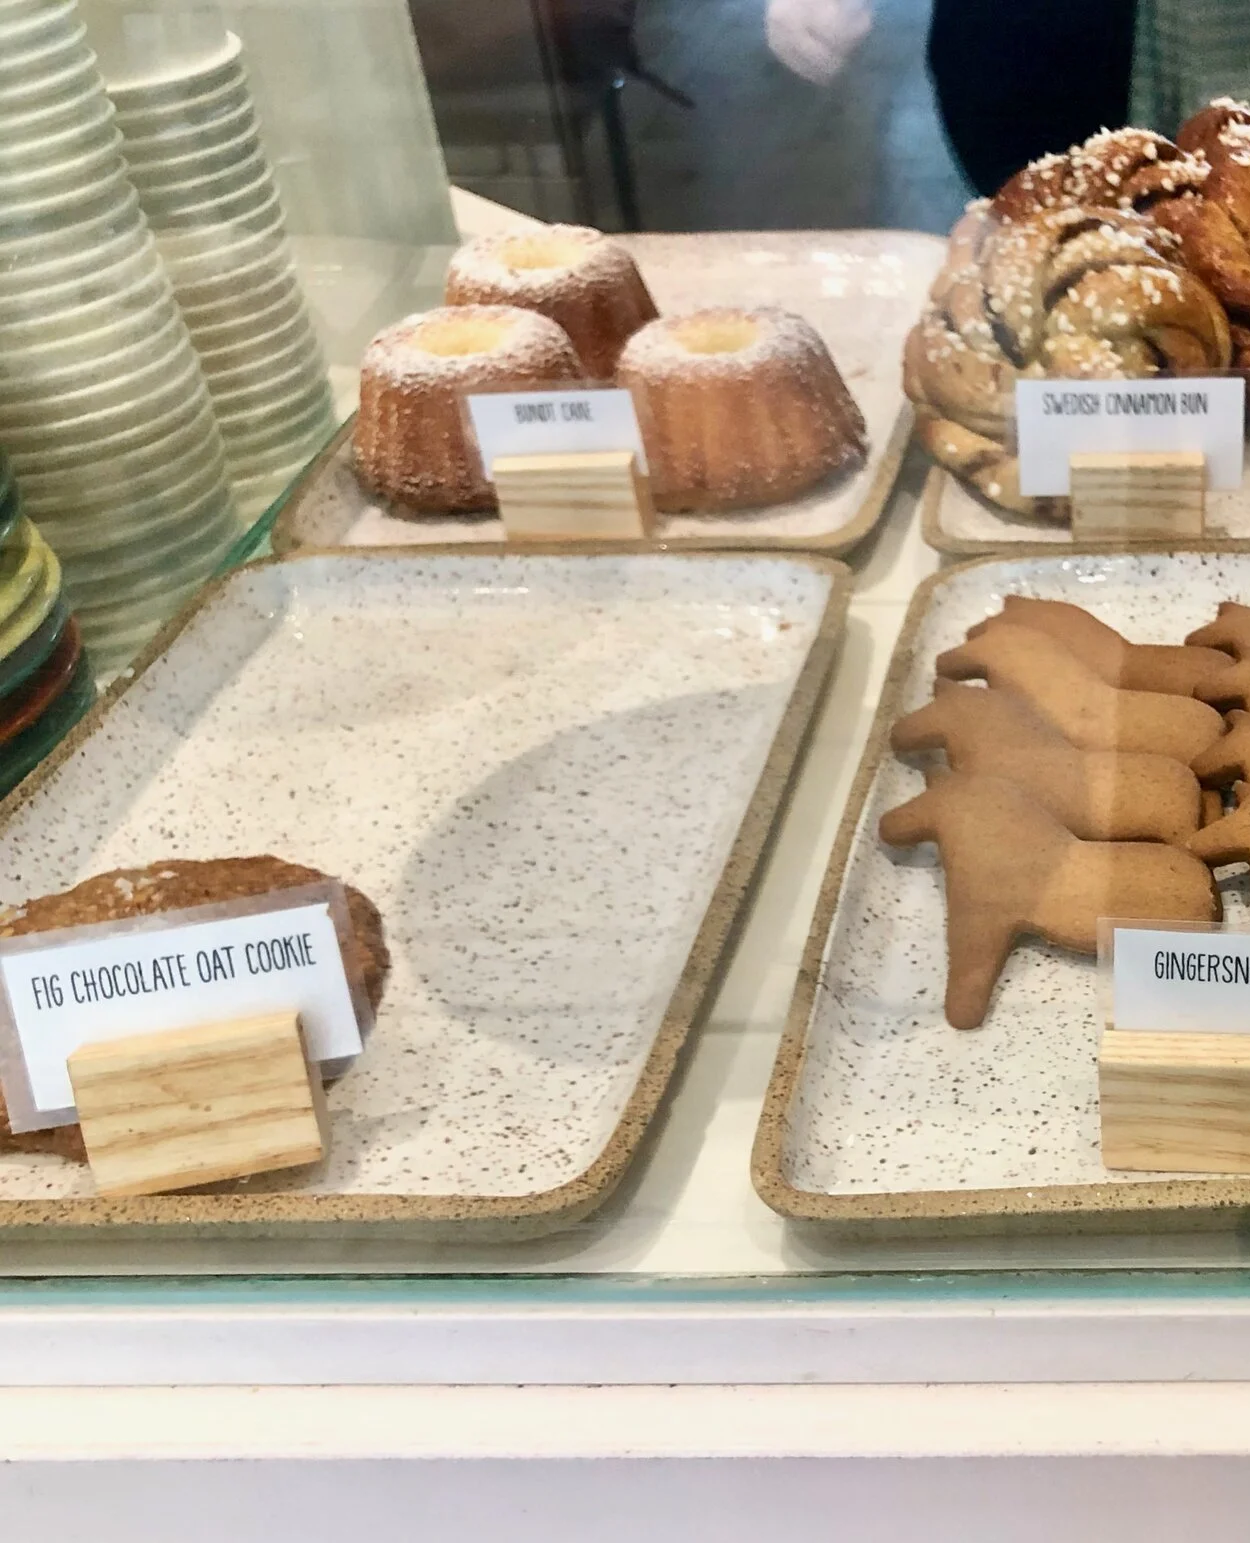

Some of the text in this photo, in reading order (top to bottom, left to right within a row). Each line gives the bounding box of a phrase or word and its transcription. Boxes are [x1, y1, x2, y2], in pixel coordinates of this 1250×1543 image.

[1042, 392, 1208, 415] SWEDISH CINNAMON BUN
[31, 933, 317, 1010] FIG CHOCOLATE OAT COOKIE
